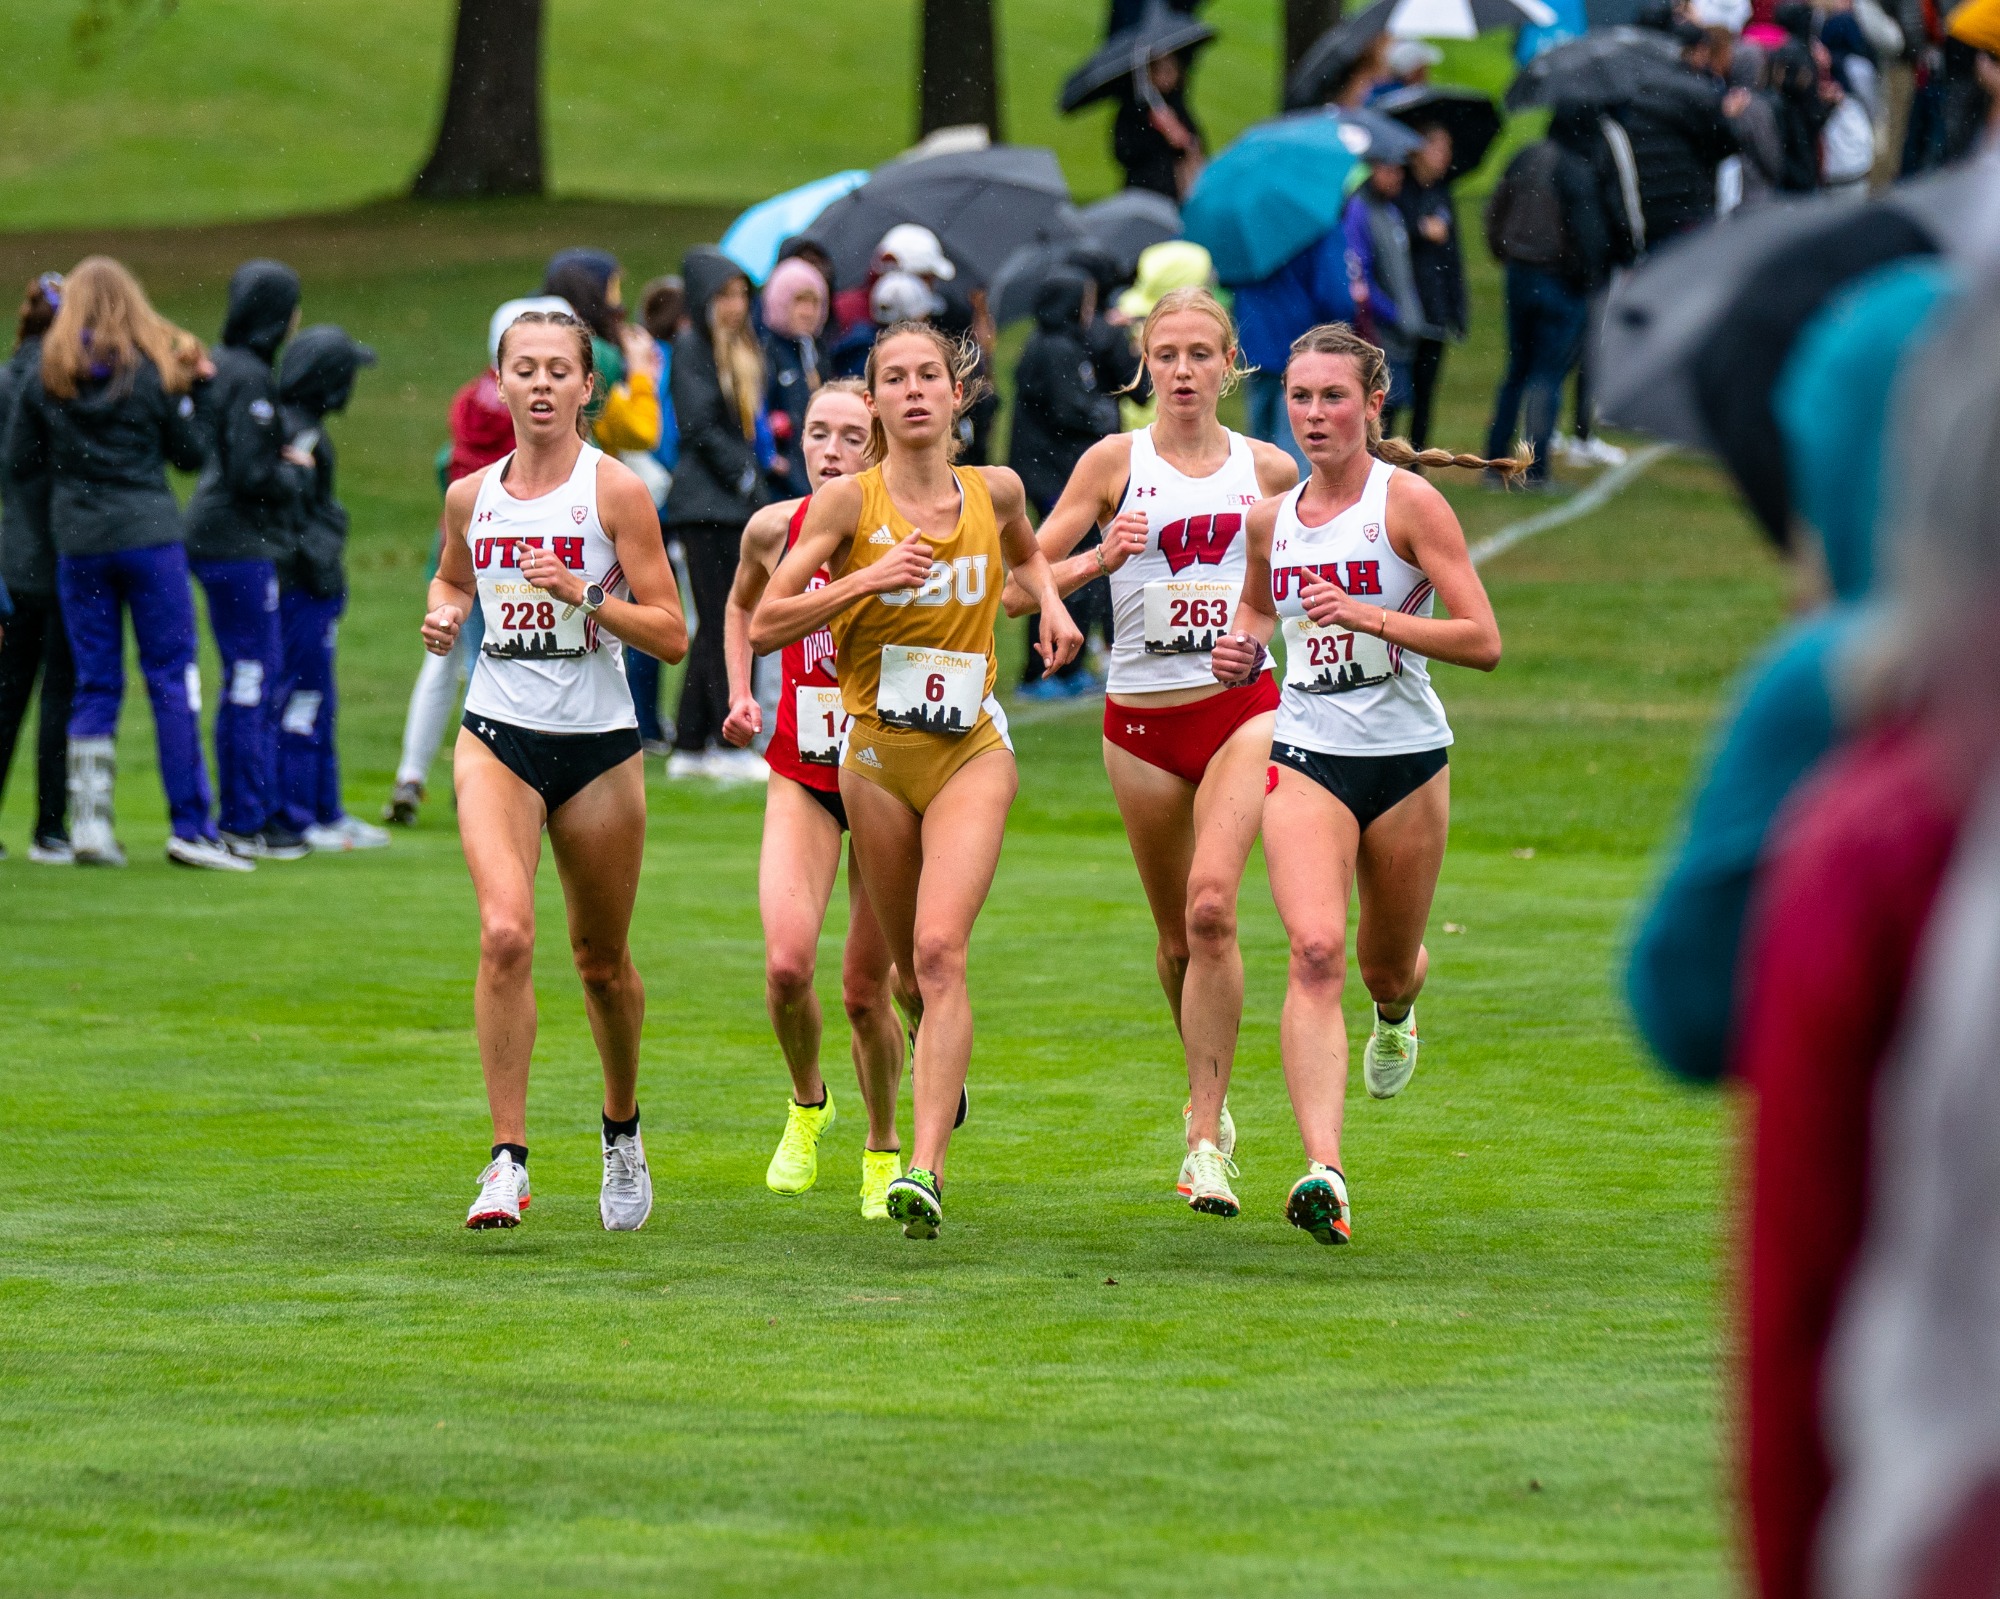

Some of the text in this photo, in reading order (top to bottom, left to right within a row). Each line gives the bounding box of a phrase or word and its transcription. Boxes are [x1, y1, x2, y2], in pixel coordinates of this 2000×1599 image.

[869, 537, 896, 546] adidas
[1158, 513, 1242, 577] W
[495, 585, 516, 594] ROY
[501, 601, 556, 630] 228
[1169, 599, 1228, 627] 263
[803, 631, 834, 674] OHIO
[906, 652, 973, 669] ROY GRIAK
[1306, 632, 1355, 666] 237
[818, 693, 841, 702] ROY
[925, 673, 946, 702] 6
